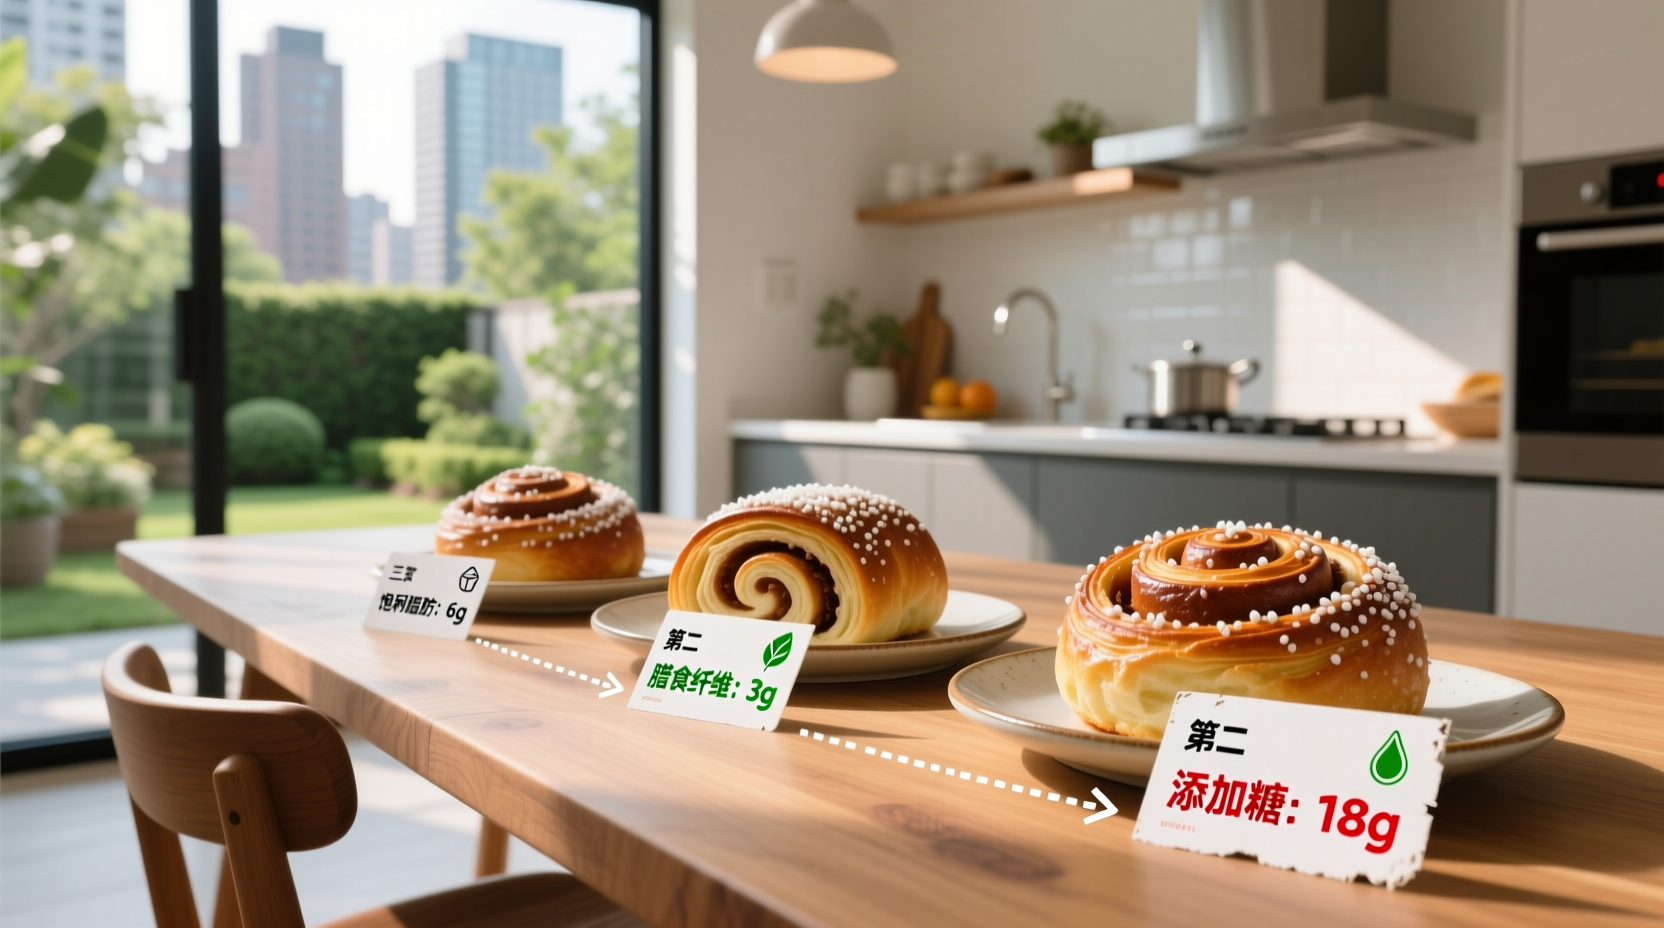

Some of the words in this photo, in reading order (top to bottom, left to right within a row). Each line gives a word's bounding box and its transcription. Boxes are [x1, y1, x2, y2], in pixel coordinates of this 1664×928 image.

[446, 602, 468, 626] 6g
[663, 628, 703, 652] 第二
[745, 678, 778, 712] 3g
[1184, 719, 1249, 756] 第二
[1318, 794, 1401, 855] 18g
